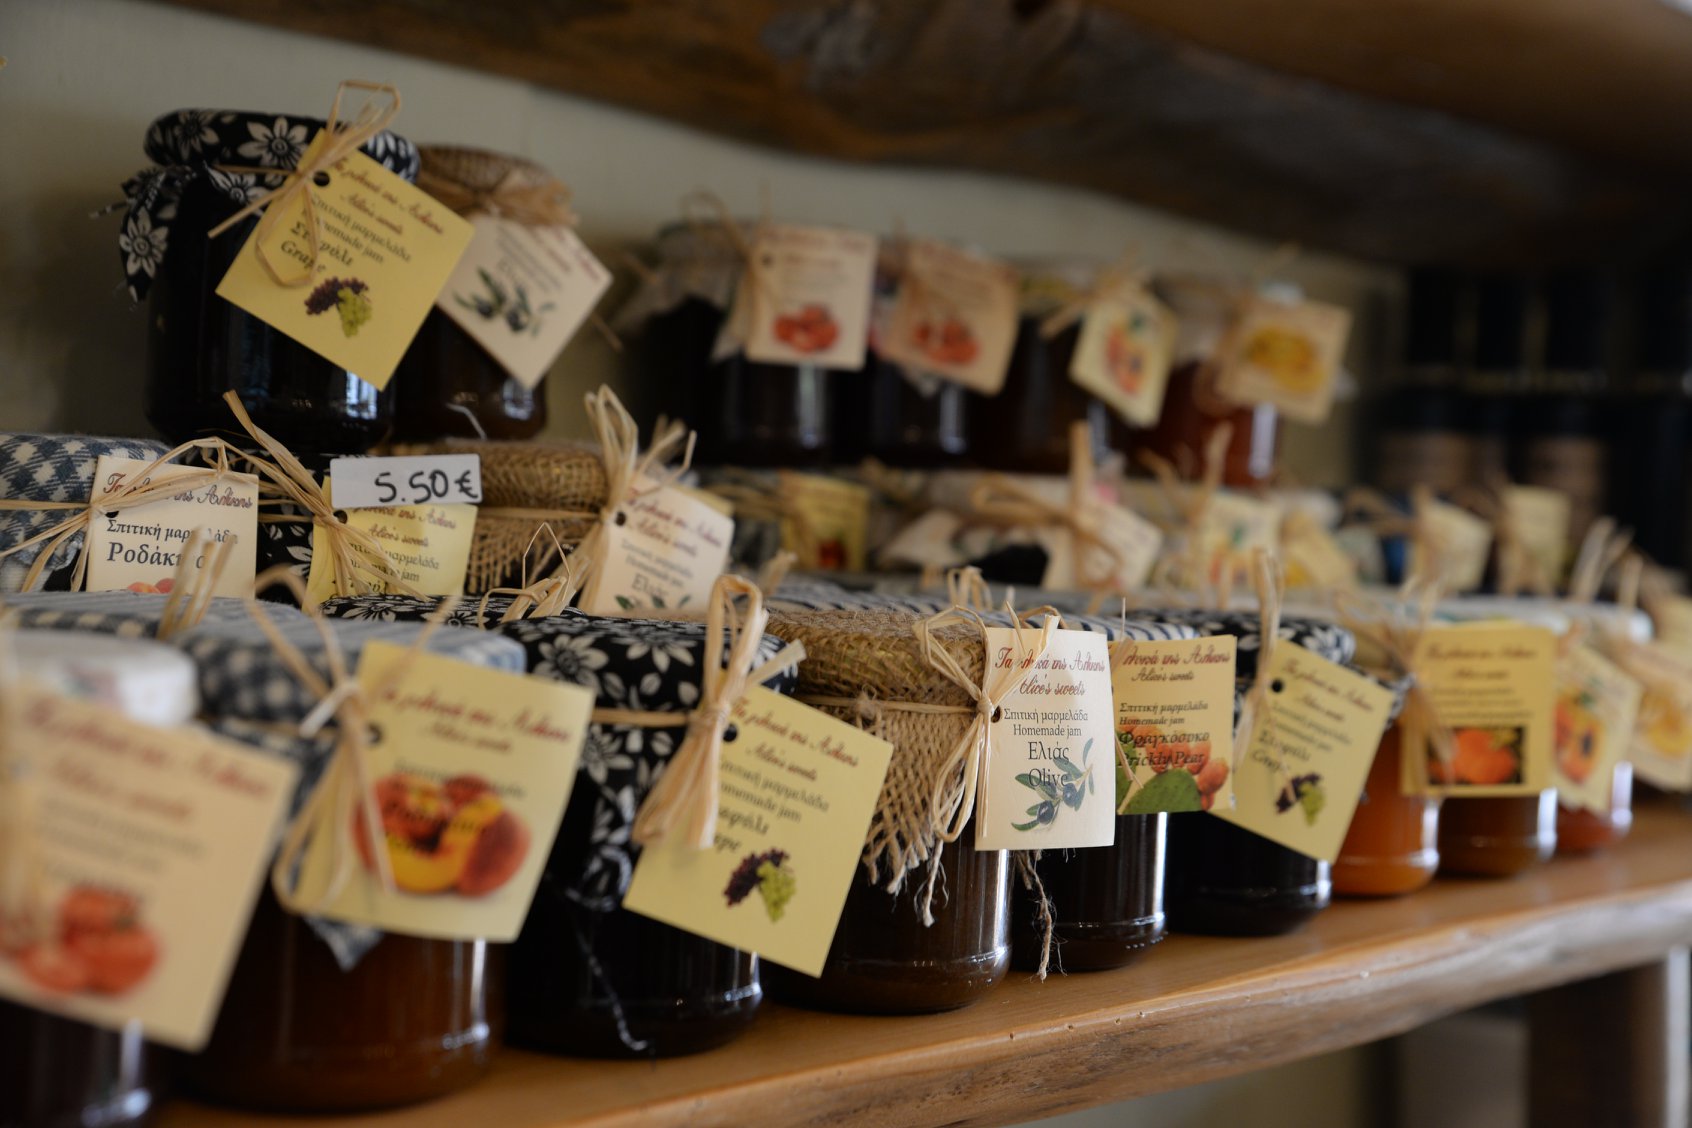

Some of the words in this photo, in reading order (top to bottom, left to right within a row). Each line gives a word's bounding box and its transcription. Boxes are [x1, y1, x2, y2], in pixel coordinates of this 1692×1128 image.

[363, 246, 385, 265] jam
[107, 519, 161, 540] Σπιτική
[107, 541, 207, 569] Ροδάκιο
[401, 571, 420, 582] jam
[1055, 680, 1085, 695] sweets
[1004, 708, 1038, 723] Σπιτική
[1041, 709, 1088, 724] μαρμελάδα
[1120, 703, 1158, 715] Σπιτική
[1160, 701, 1208, 714] μαρμελάδα
[1120, 716, 1167, 725] Homemade
[1169, 718, 1184, 726] jam
[1014, 724, 1065, 736] Homemade
[1066, 726, 1082, 738] jam
[1119, 730, 1210, 748] Φραγκόσυκο
[1028, 742, 1069, 764] Ελιάς
[1028, 768, 1068, 786] Olive
[720, 782, 777, 811] omemade
